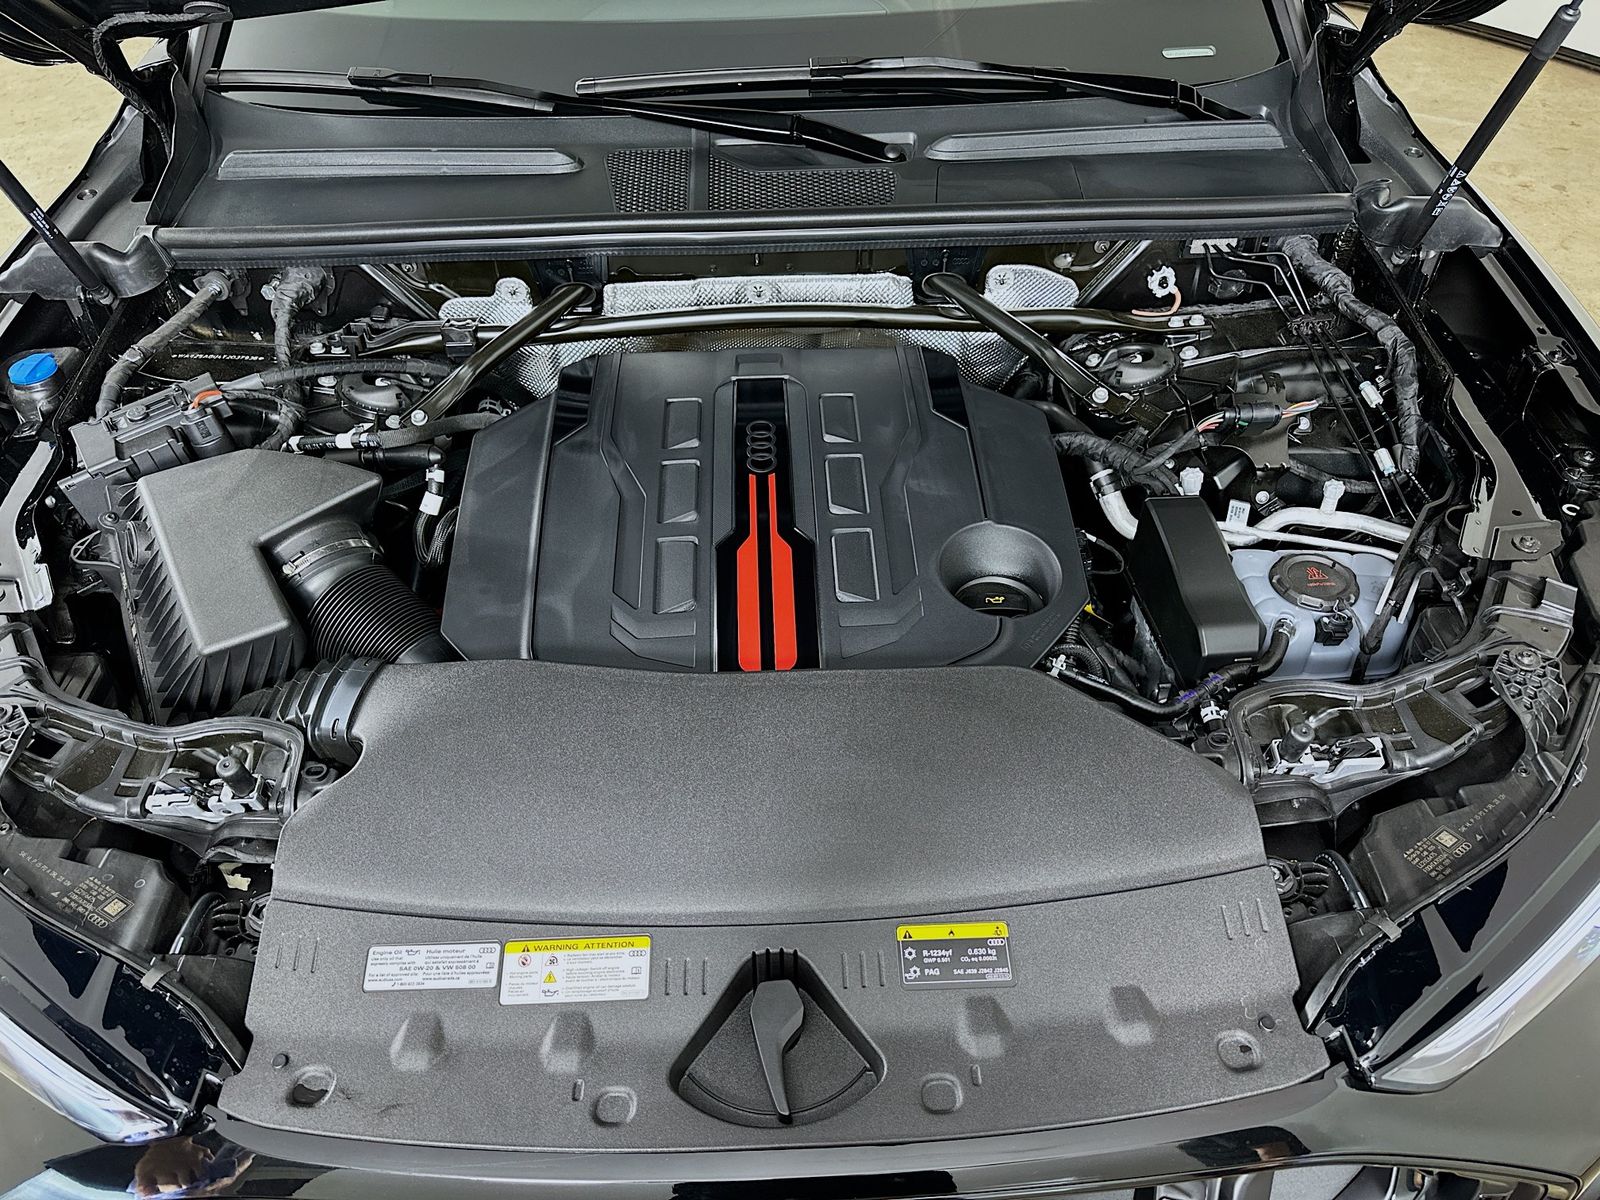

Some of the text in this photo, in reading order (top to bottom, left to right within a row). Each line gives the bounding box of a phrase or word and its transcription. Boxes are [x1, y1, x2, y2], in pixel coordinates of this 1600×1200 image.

[534, 941, 634, 952] WARNING ATTENTION
[922, 949, 953, 958] R-1234yf
[987, 948, 997, 956] kg
